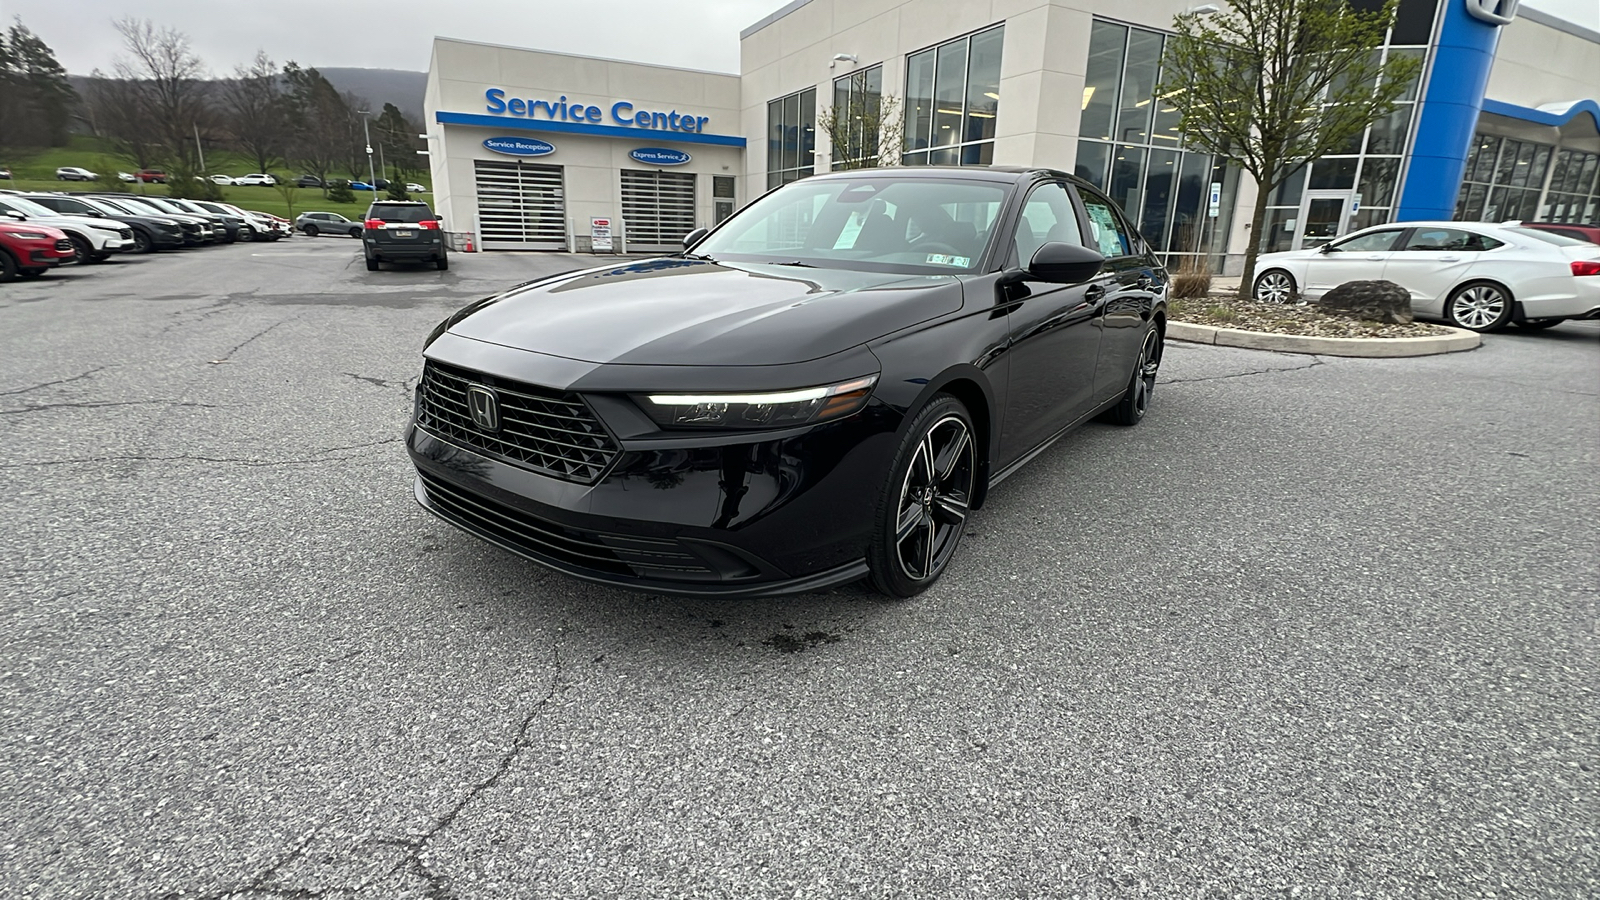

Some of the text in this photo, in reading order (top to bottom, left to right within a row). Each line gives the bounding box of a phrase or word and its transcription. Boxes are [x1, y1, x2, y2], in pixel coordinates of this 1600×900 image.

[485, 88, 709, 132] Service Center
[487, 140, 551, 151] Service Reception
[633, 151, 656, 159] Express
